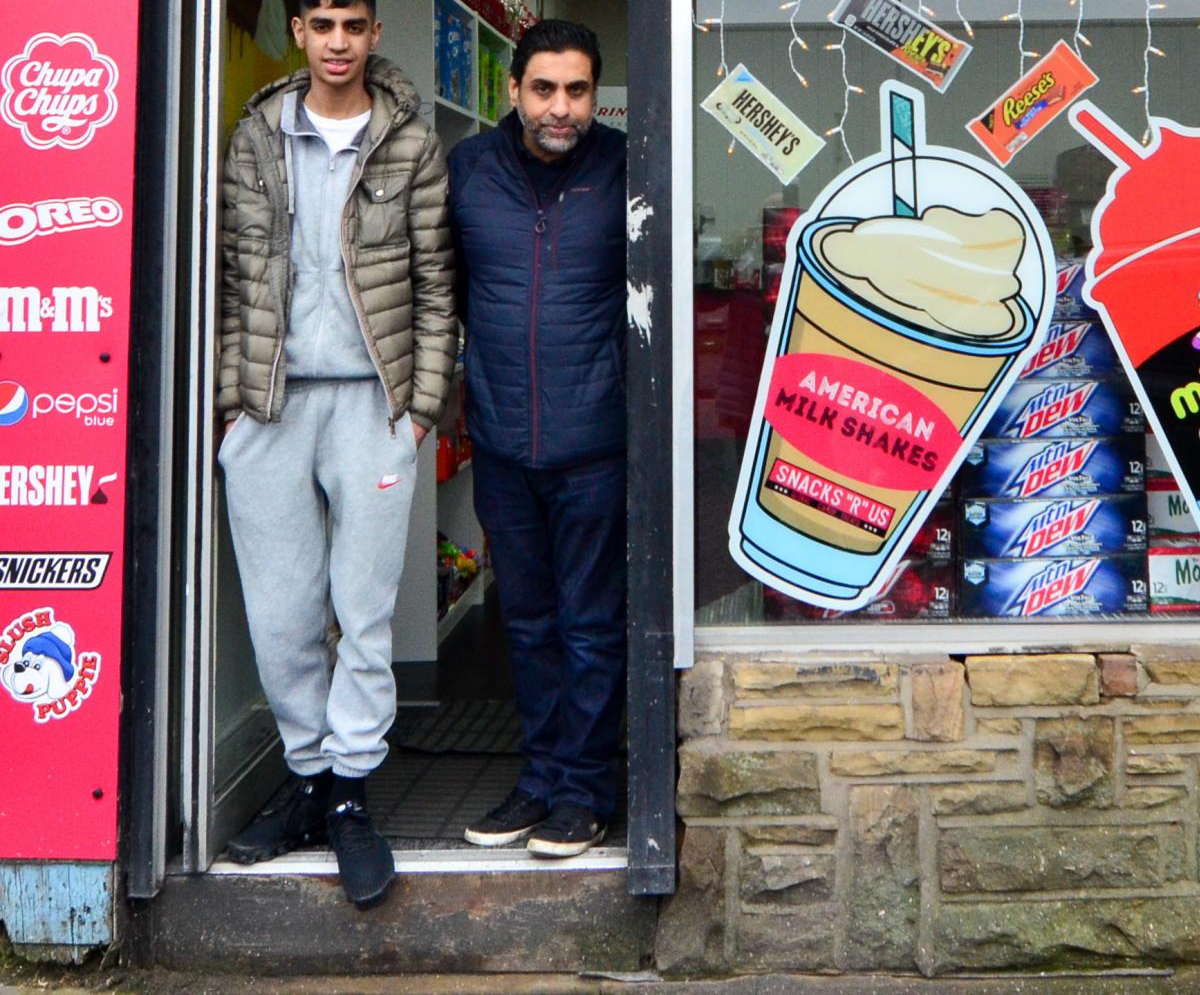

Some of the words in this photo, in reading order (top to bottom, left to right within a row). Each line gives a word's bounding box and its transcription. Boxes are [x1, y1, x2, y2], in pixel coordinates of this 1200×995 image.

[19, 60, 104, 94] Chupa
[14, 87, 100, 122] Chups
[731, 89, 801, 156] HERSHEY'S
[0, 198, 119, 240] OREO
[32, 388, 118, 418] pepsi
[84, 414, 115, 426] blue
[799, 370, 936, 442] AMERICAN
[775, 387, 839, 431] MILK
[840, 416, 939, 473] SHAKES
[0, 465, 95, 506] ERSHEY
[775, 465, 844, 507] SNACKS
[868, 504, 890, 527] US
[36, 655, 98, 720] PUPPIE
